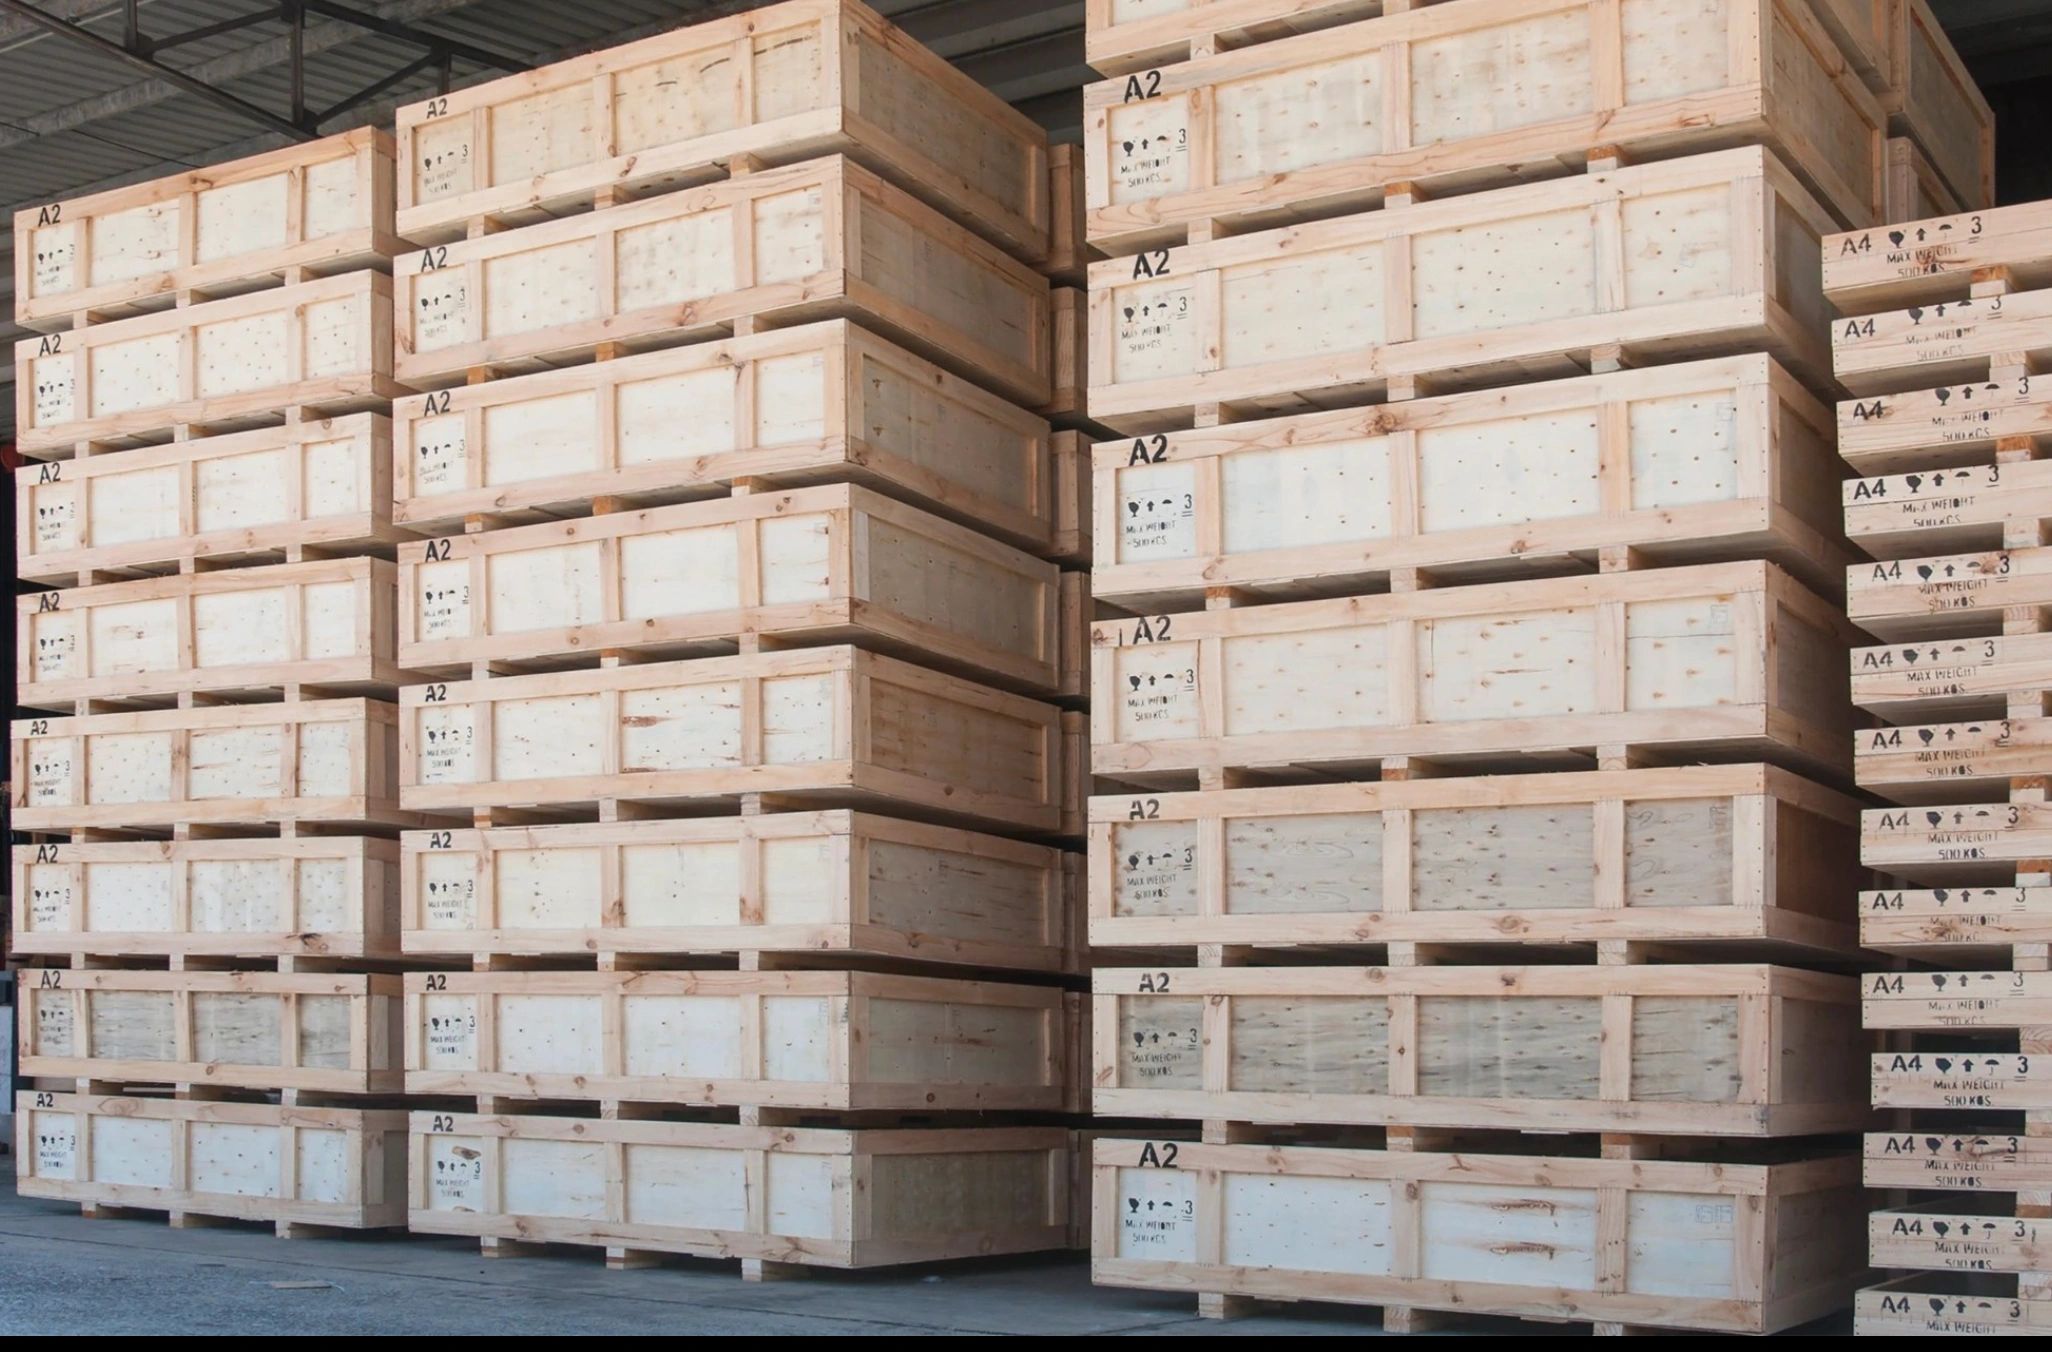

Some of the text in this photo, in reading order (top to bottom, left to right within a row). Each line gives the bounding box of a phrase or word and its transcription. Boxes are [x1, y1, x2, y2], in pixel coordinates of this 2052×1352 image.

[1124, 70, 1161, 103] A2
[427, 98, 447, 119] A2
[1179, 128, 1186, 143] 3
[463, 145, 468, 157] 3
[38, 205, 61, 227] A2
[1971, 216, 1982, 234] 3
[1841, 233, 1871, 256] A4
[421, 246, 447, 272] A2
[1133, 249, 1169, 279] A2
[1887, 253, 1910, 264] MAX
[460, 288, 465, 301] 3
[1180, 297, 1187, 311] 3
[1845, 318, 1875, 338] A4
[39, 334, 62, 357] A2
[2018, 377, 2029, 394] 3
[424, 391, 450, 416] A2
[1853, 401, 1883, 420] A4
[460, 439, 464, 452] 3
[1129, 434, 1167, 466] A2
[39, 463, 60, 484] A2
[1989, 463, 1999, 482] 3
[1854, 479, 1886, 500] A4
[1184, 494, 1192, 509] 3
[426, 539, 451, 562] A2
[1872, 560, 1901, 582] A4
[2000, 556, 2009, 574] 3
[464, 586, 469, 598] 3
[39, 593, 60, 612] A2
[1133, 615, 1171, 644] A2
[1984, 640, 1994, 657] 3
[1863, 651, 1893, 668] A4
[1186, 669, 1194, 683] 3
[1907, 671, 1931, 681] MAX
[425, 684, 446, 702] A2
[31, 720, 47, 735] A2
[467, 726, 472, 739] 3
[2000, 721, 2010, 738] 3
[1872, 729, 1902, 750] A4
[1129, 799, 1159, 820] A2
[2008, 806, 2019, 824] 3
[1880, 811, 1910, 830] A4
[430, 831, 451, 848] A2
[37, 845, 57, 863] A2
[1185, 848, 1192, 863] 3
[468, 880, 473, 892] 3
[1872, 893, 1903, 910] A4
[2015, 888, 2026, 903] 3
[40, 971, 61, 989] A2
[426, 974, 446, 991] A2
[1139, 972, 1169, 993] A2
[1873, 976, 1904, 993] A4
[2013, 971, 2023, 987] 3
[470, 1016, 475, 1027] 3
[1190, 1028, 1197, 1043] 3
[1891, 1055, 1922, 1072] A4
[2018, 1056, 2028, 1073] 3
[37, 1094, 53, 1108] A2
[433, 1115, 453, 1132] A2
[1885, 1136, 1915, 1153] A4
[2008, 1137, 2017, 1154] 3
[1139, 1142, 1177, 1168] A2
[475, 1162, 480, 1174] 3
[1185, 1200, 1193, 1214] 3
[1892, 1218, 1923, 1235] A4
[2015, 1220, 2025, 1237] 3
[1963, 1244, 2004, 1255] WEIGH
[1881, 1296, 1910, 1313] A4
[2010, 1301, 2020, 1317] 3
